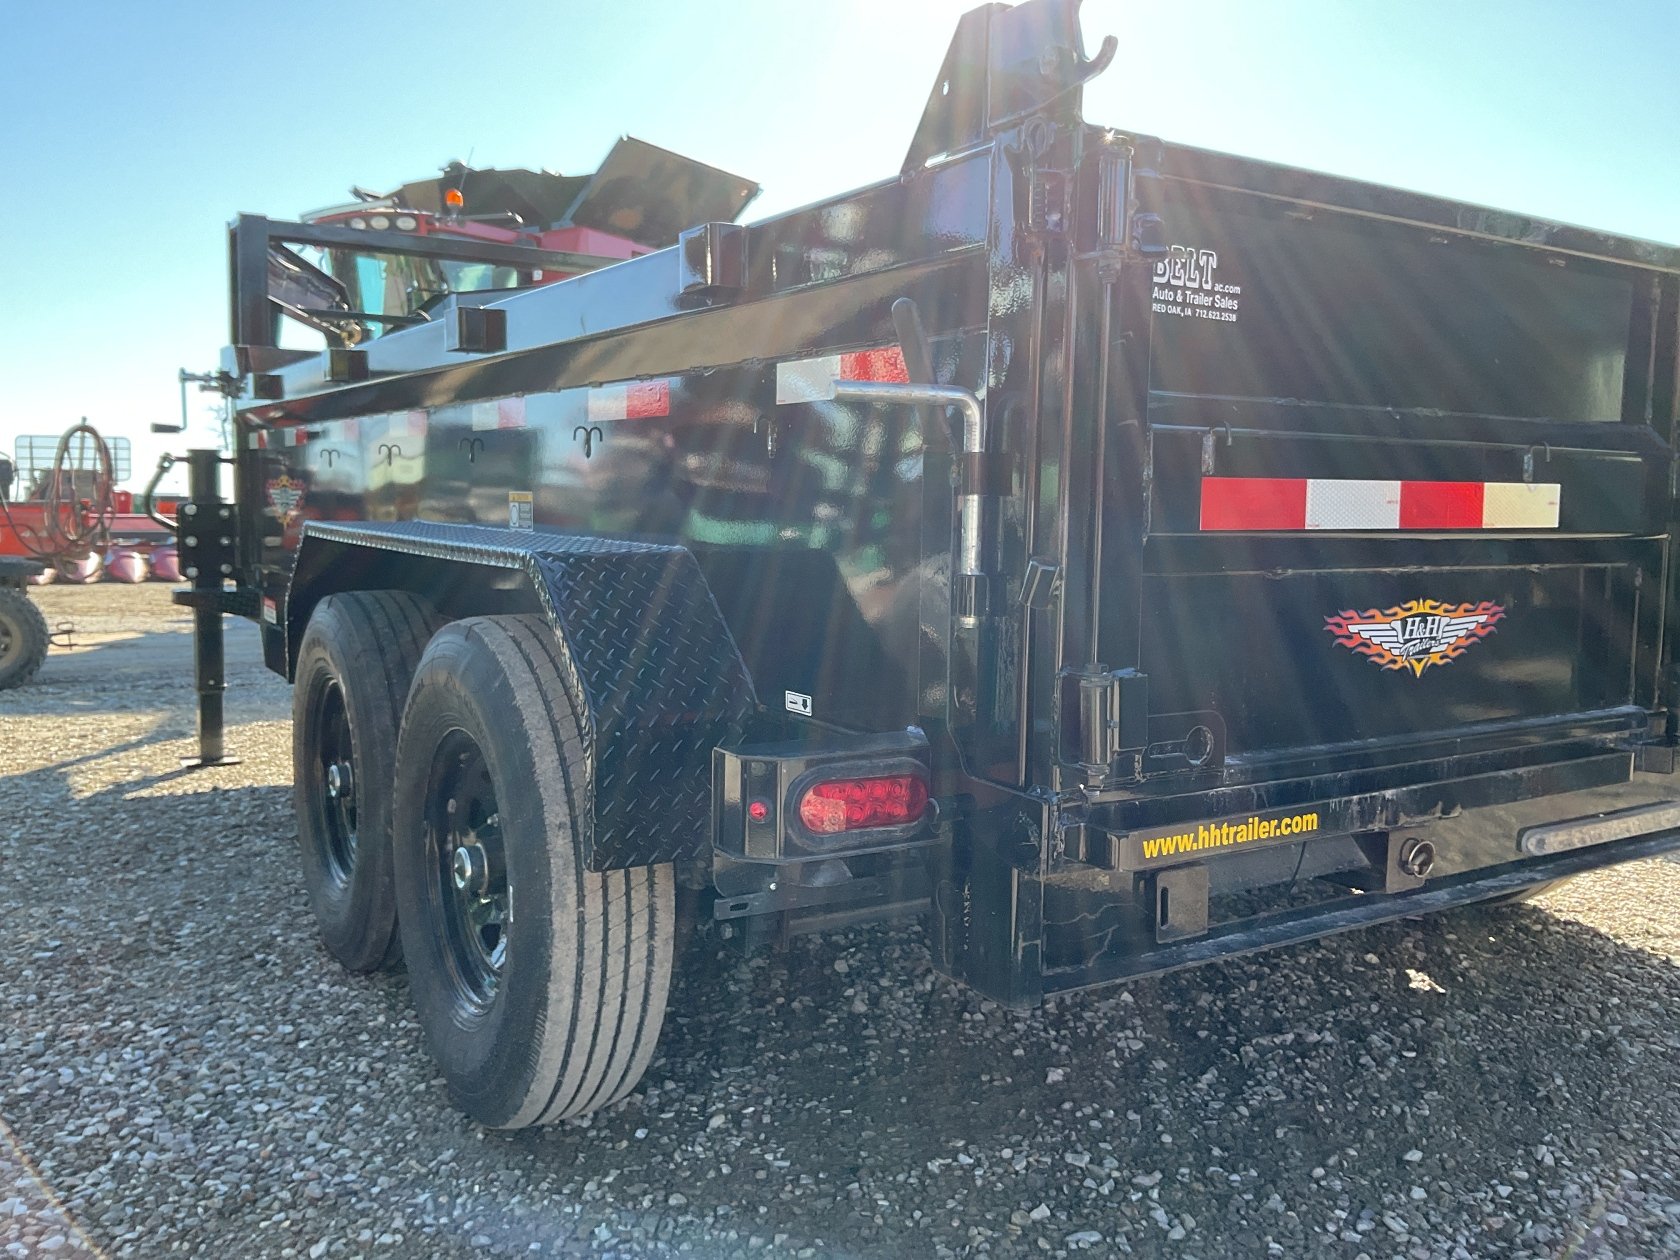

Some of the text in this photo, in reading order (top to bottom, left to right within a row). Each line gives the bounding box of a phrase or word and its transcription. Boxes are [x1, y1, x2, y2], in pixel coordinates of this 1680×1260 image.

[1153, 245, 1241, 294] BELT ac.com
[1152, 286, 1238, 310] Auto & Trailer Sales
[1152, 303, 1237, 322] RED OAK, IA 712.623.2538
[1403, 616, 1441, 639] H&H
[1399, 638, 1440, 662] Trailers
[1142, 812, 1318, 859] www.hhtrailer.com
